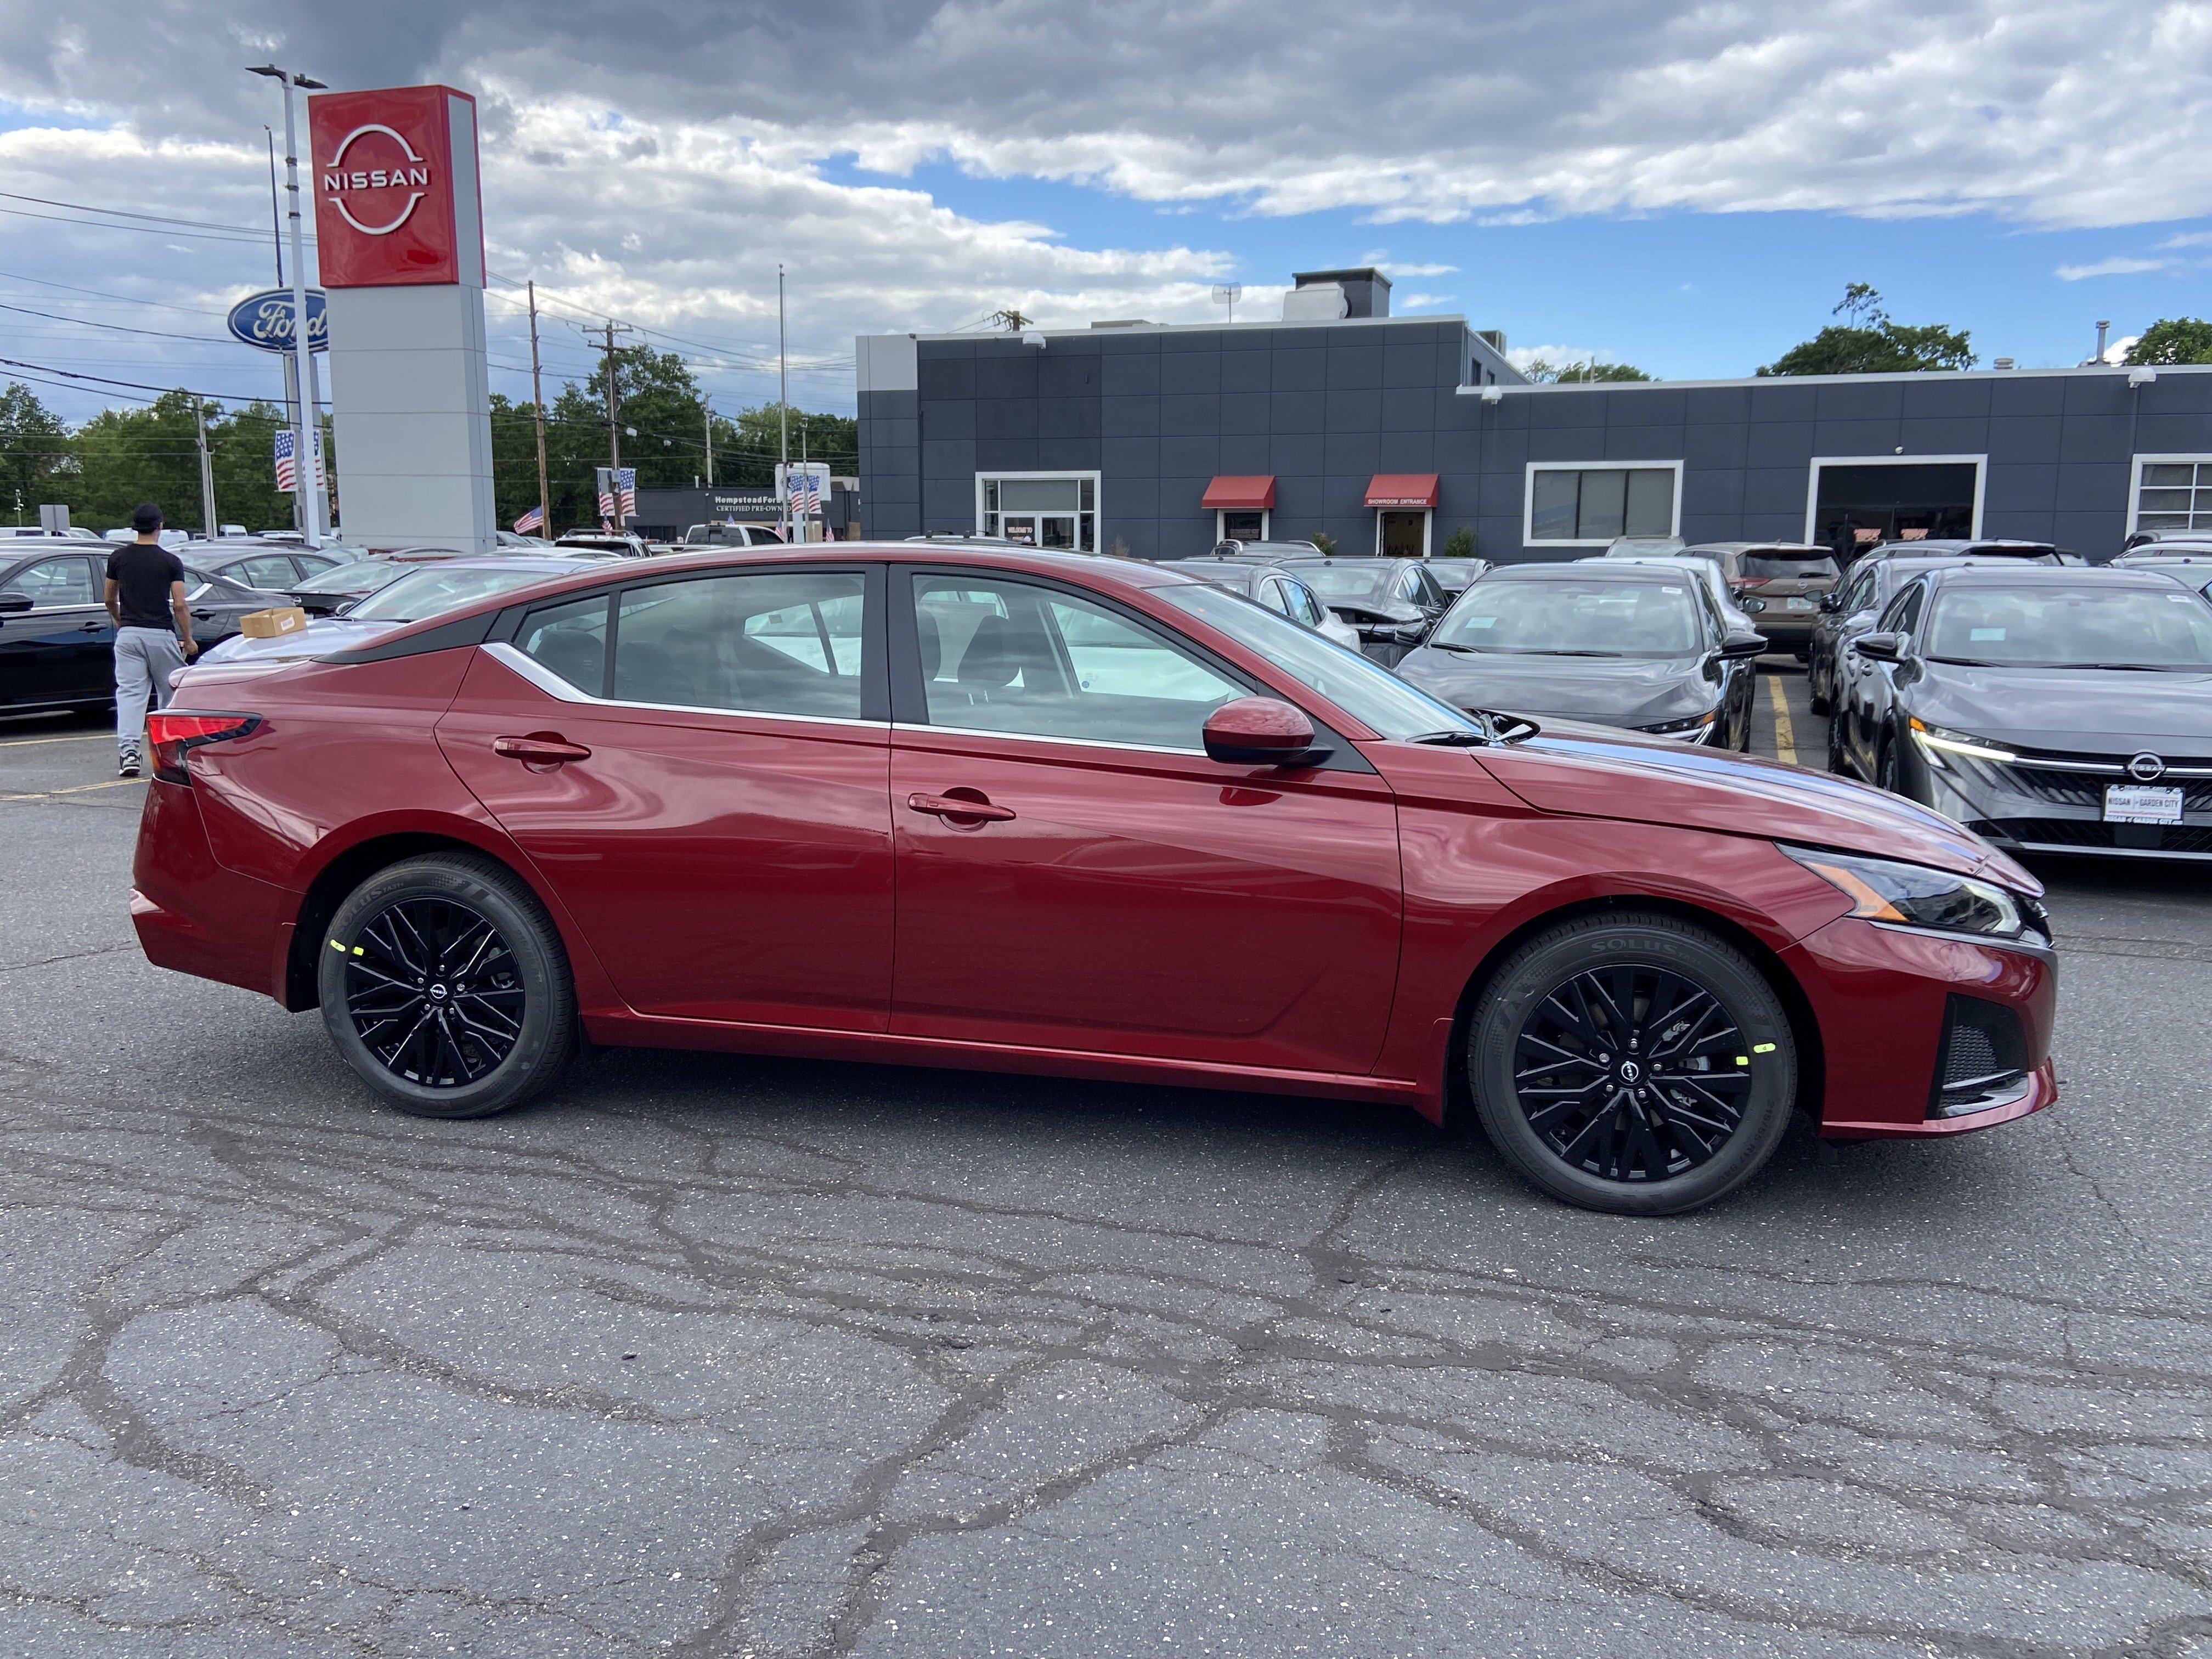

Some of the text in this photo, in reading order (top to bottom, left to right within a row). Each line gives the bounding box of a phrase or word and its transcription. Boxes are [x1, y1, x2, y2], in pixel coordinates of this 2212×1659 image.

[324, 167, 428, 191] NISSAN
[253, 301, 328, 339] Fod
[2108, 797, 2131, 805] NISSAN
[2140, 798, 2163, 807] GARDEN
[2164, 799, 2180, 808] CITY
[1590, 938, 1678, 955] SOLUS
